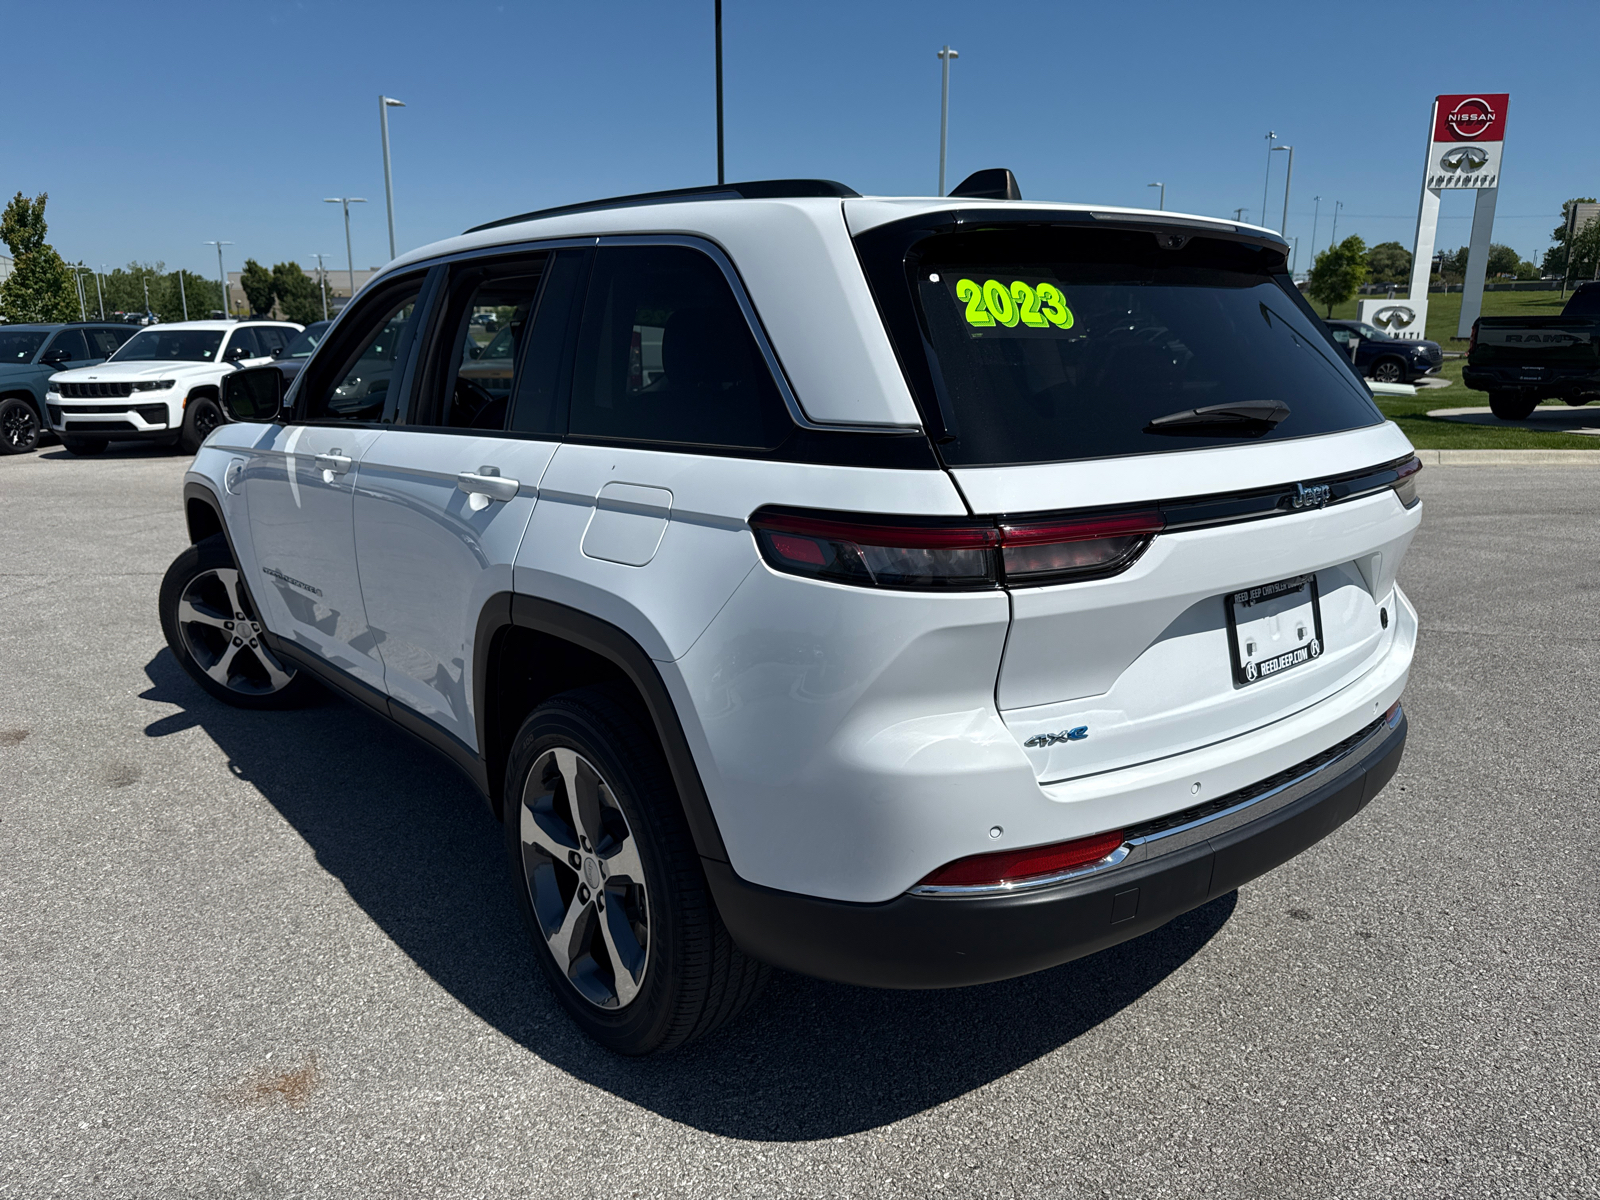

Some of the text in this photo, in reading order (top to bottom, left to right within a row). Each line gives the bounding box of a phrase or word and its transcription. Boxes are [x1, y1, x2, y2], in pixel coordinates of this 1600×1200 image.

[1448, 113, 1496, 121] NISSAN
[1429, 174, 1496, 185] INFINITI
[956, 278, 1074, 329] 2023
[1388, 331, 1420, 340] NITI
[1505, 334, 1563, 343] RAM
[1292, 482, 1331, 509] Jeep
[1234, 591, 1249, 604] REED
[1249, 588, 1262, 600] JEEP
[1260, 647, 1309, 676] REEDJEEP.COM
